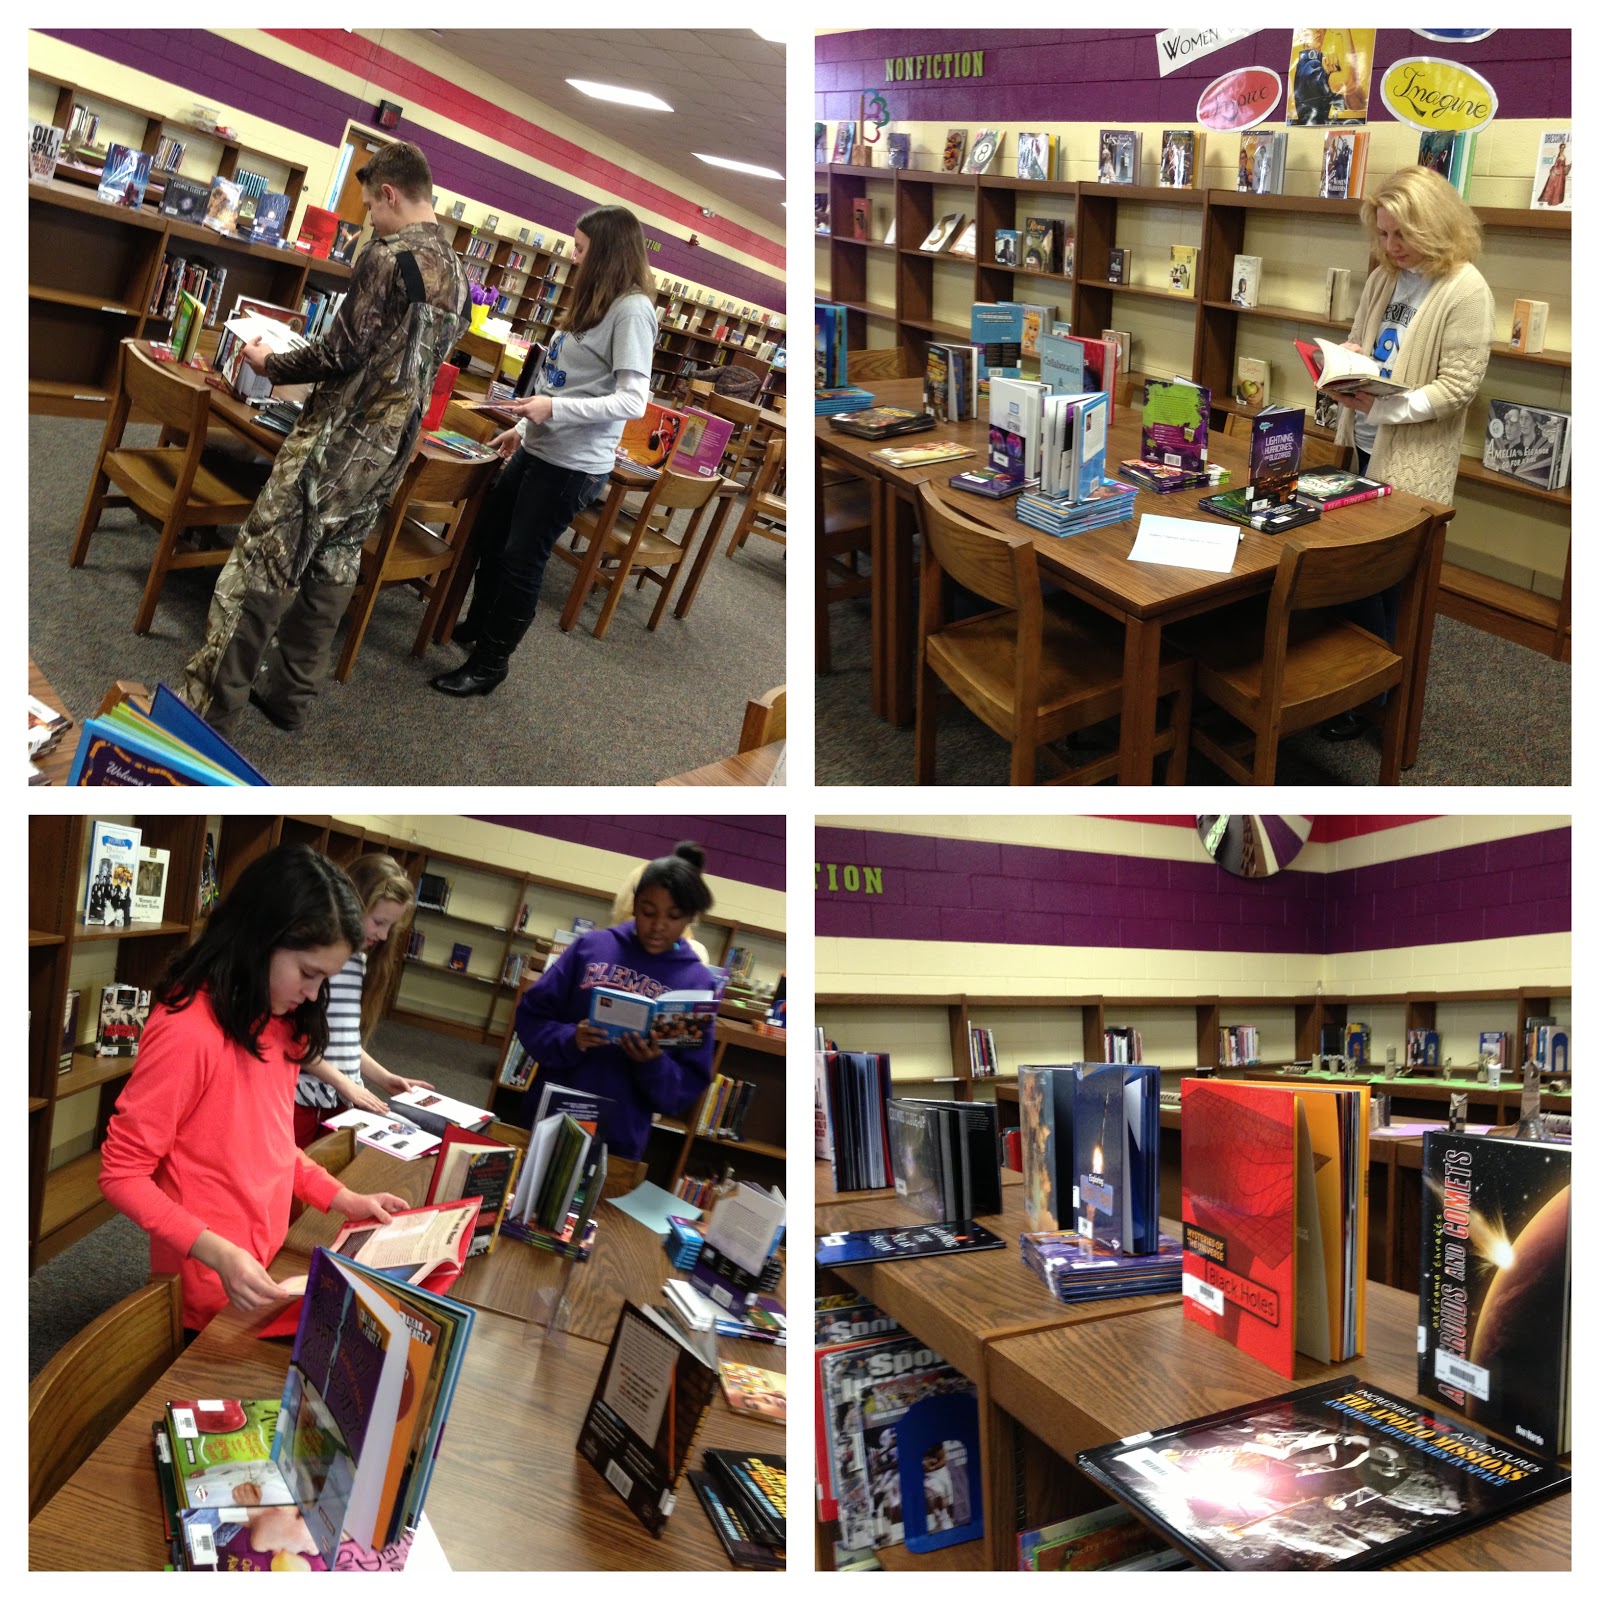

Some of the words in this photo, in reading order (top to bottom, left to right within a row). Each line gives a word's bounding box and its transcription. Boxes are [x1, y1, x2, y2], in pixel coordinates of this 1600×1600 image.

[1163, 27, 1219, 60] WOMEN
[885, 50, 984, 82] NONFICTION
[1393, 67, 1488, 118] Imagine
[33, 125, 55, 146] OIL
[1043, 355, 1081, 375] Collaboration
[1265, 432, 1295, 447] LIGHTNING,
[1485, 438, 1517, 460] AMELIA
[106, 761, 144, 786] Welcome
[1443, 1149, 1472, 1240] COMETS
[1187, 1228, 1216, 1248] MYSTERIES
[1444, 1242, 1467, 1282] AND
[1209, 1267, 1237, 1298] Black
[1241, 1282, 1275, 1317] Holes
[1438, 1283, 1468, 1406] AROIDS
[1322, 1399, 1346, 1413] AND
[1343, 1408, 1381, 1426] OTHER
[1377, 1424, 1451, 1459] ADVENTURES
[1461, 1463, 1512, 1487] SPACE
[1336, 1393, 1375, 1412] THE
[1368, 1405, 1437, 1439] APOLLO
[1433, 1436, 1530, 1481] MISSIONS
[1354, 1389, 1419, 1419] INCREDIBLE
[1450, 1432, 1544, 1474] ADVENTURES
